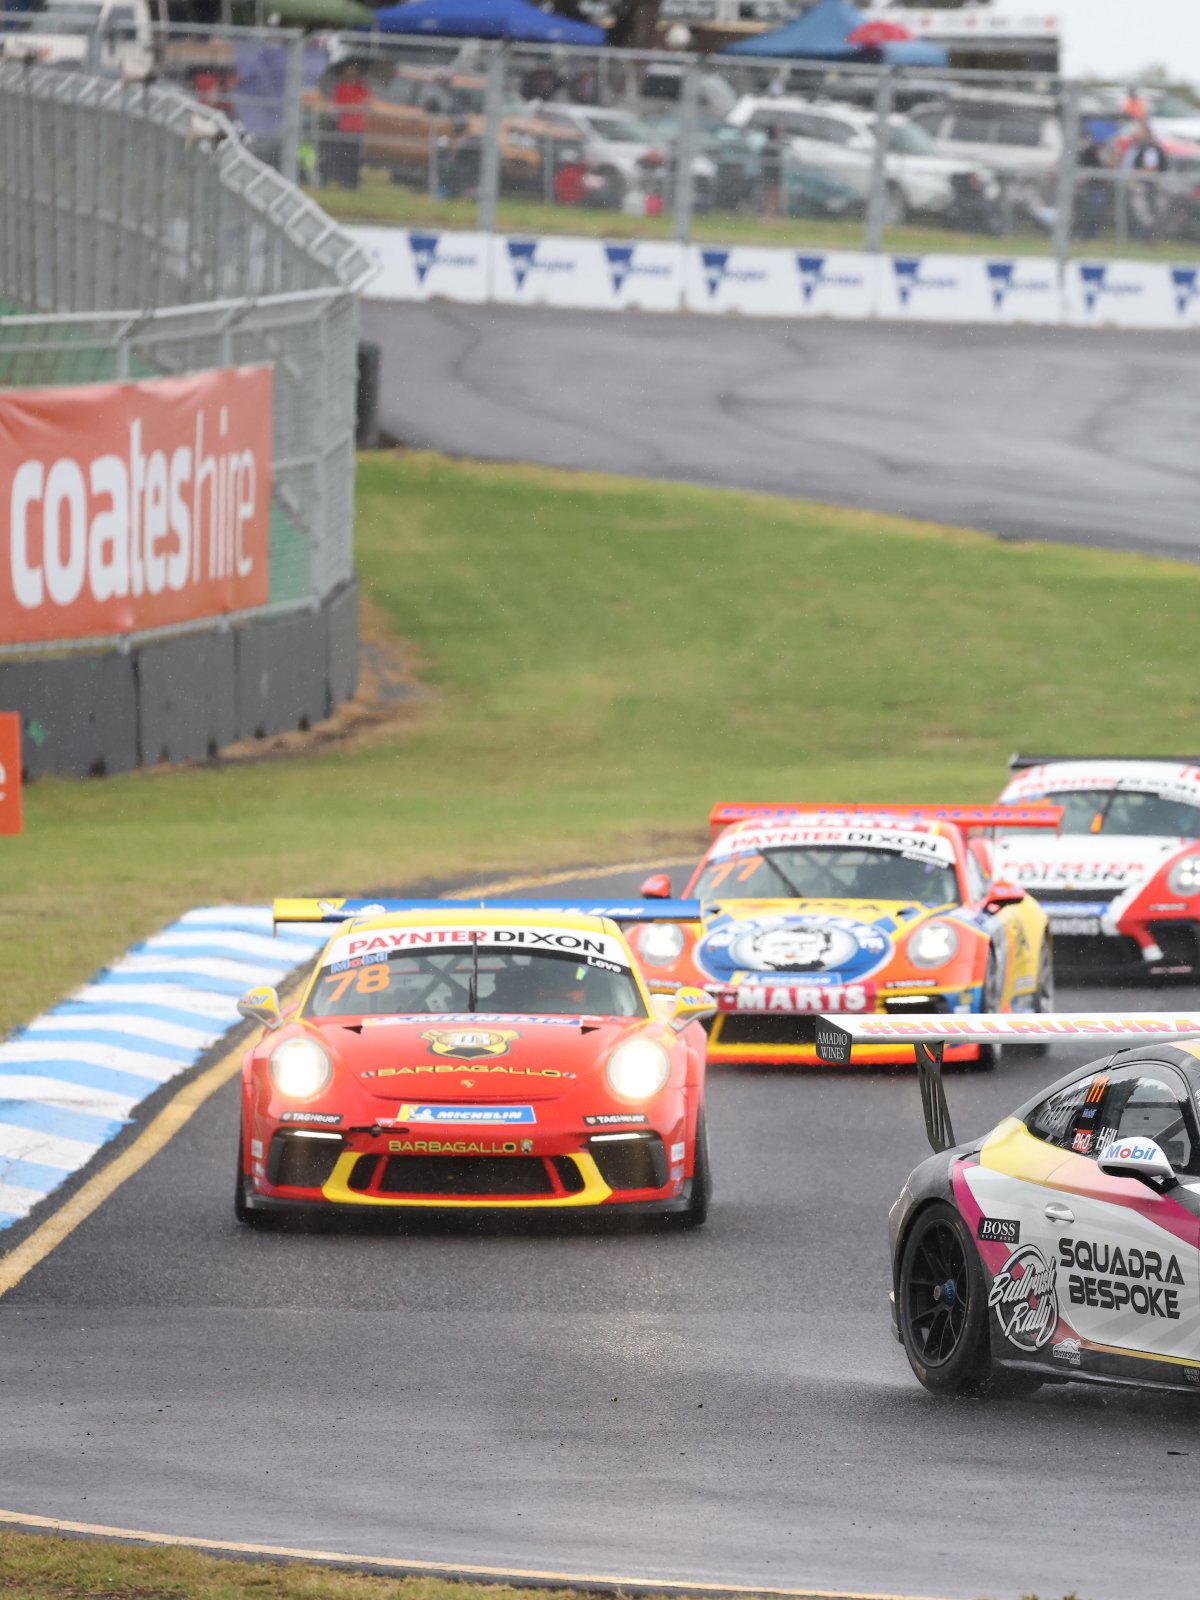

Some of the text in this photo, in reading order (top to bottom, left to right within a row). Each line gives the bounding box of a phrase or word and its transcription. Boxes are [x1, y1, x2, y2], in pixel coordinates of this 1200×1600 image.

[732, 832, 937, 852] PAYNTER DIXON
[709, 855, 765, 888] 77
[331, 951, 390, 974] Mobil
[587, 956, 622, 973] Love
[325, 963, 391, 1002] 78
[817, 1032, 848, 1046] AMADIO
[820, 1046, 845, 1060] WINES
[377, 1065, 562, 1078] BARBAGALLO
[437, 1111, 523, 1120] MICHELIN
[389, 1140, 518, 1152] BARBAGALLO
[1072, 1132, 1092, 1151] PRO
[1095, 1126, 1118, 1151] Hill
[1105, 1145, 1157, 1161] Mobil
[983, 1220, 1016, 1237] BOSS
[1058, 1237, 1186, 1286] SQUADRA
[988, 1255, 1058, 1308] Bullrush
[1068, 1274, 1181, 1320] BESPOKE
[1004, 1293, 1054, 1348] Rally
